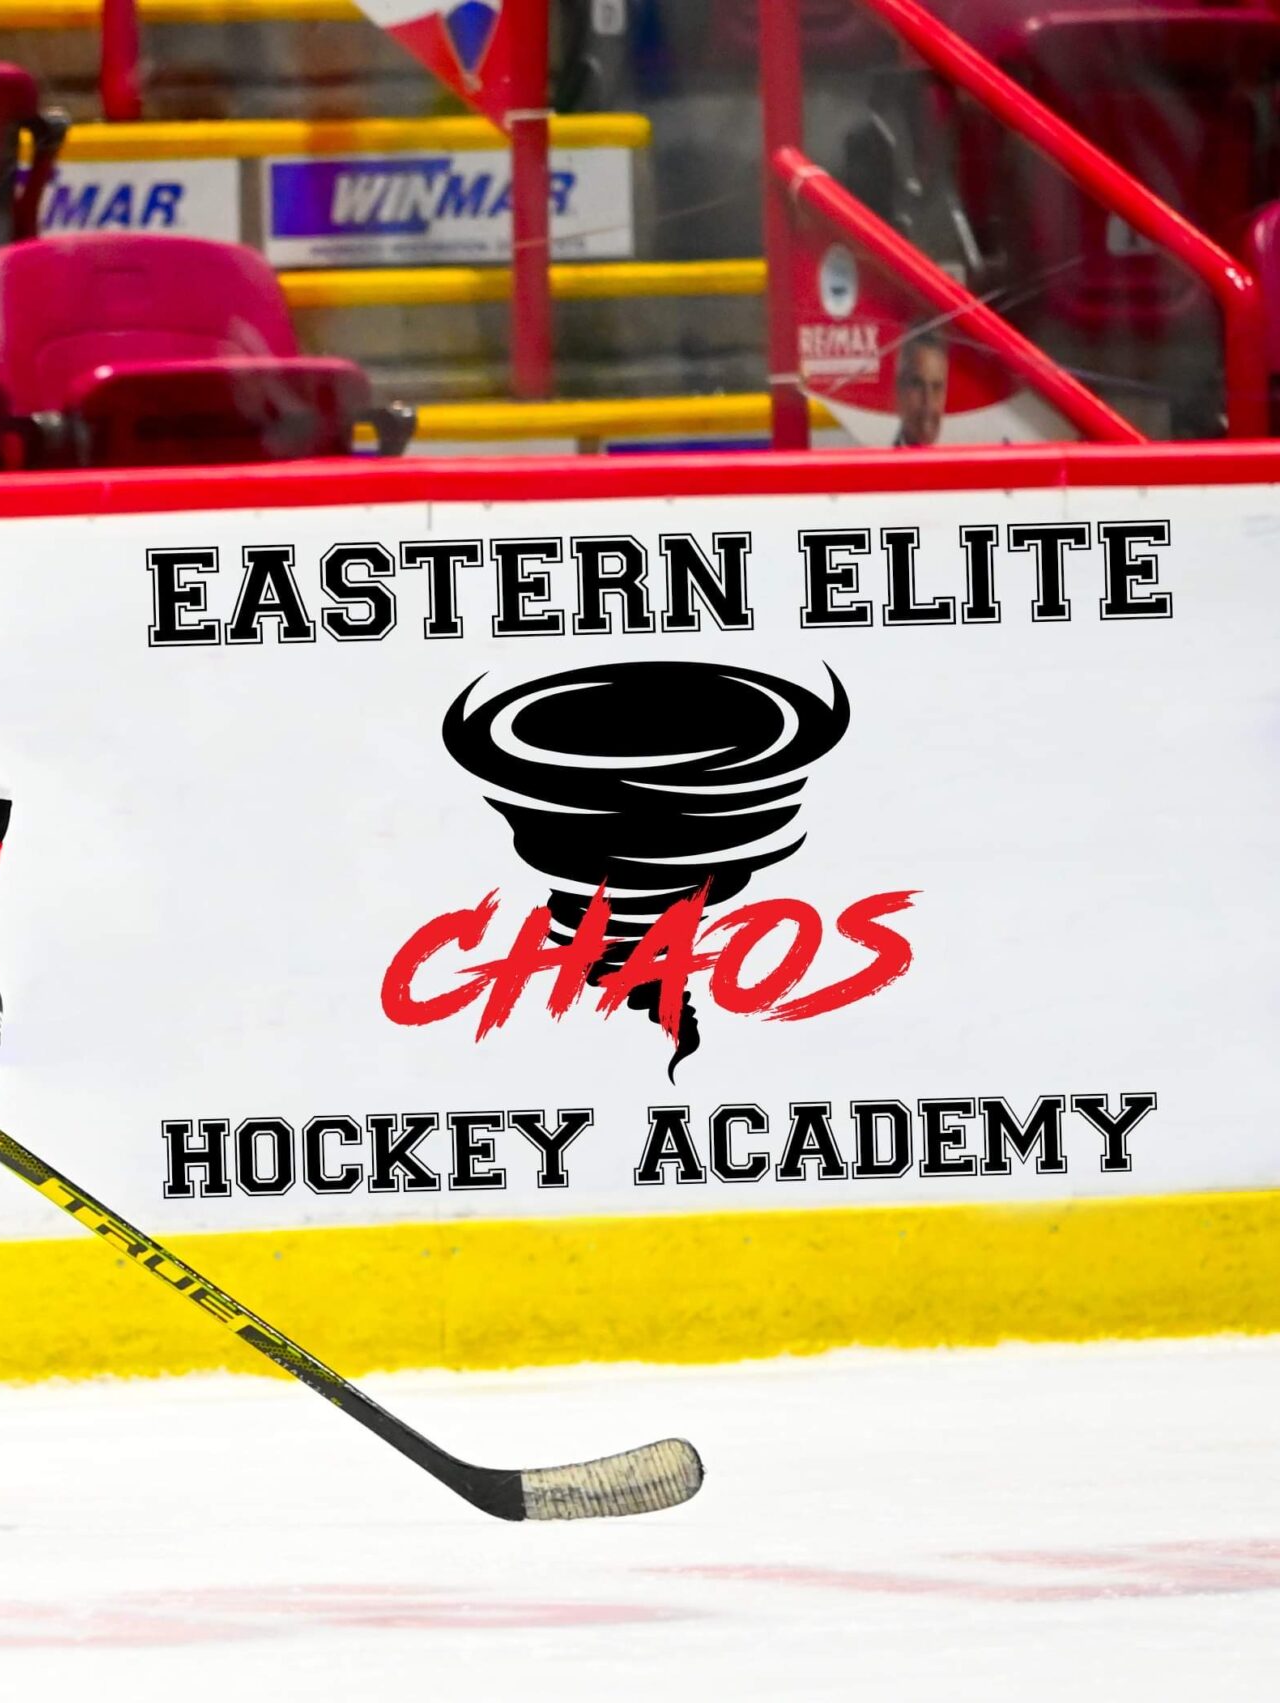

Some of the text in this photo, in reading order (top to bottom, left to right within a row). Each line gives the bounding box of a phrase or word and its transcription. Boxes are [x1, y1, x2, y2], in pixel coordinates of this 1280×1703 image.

[41, 182, 184, 229] MAR
[146, 520, 1173, 647] EASTERN ELITE
[381, 880, 924, 1045] CHAOS
[162, 1092, 1157, 1199] HOCKEY ACADEMY
[58, 1184, 247, 1324] TRUE
